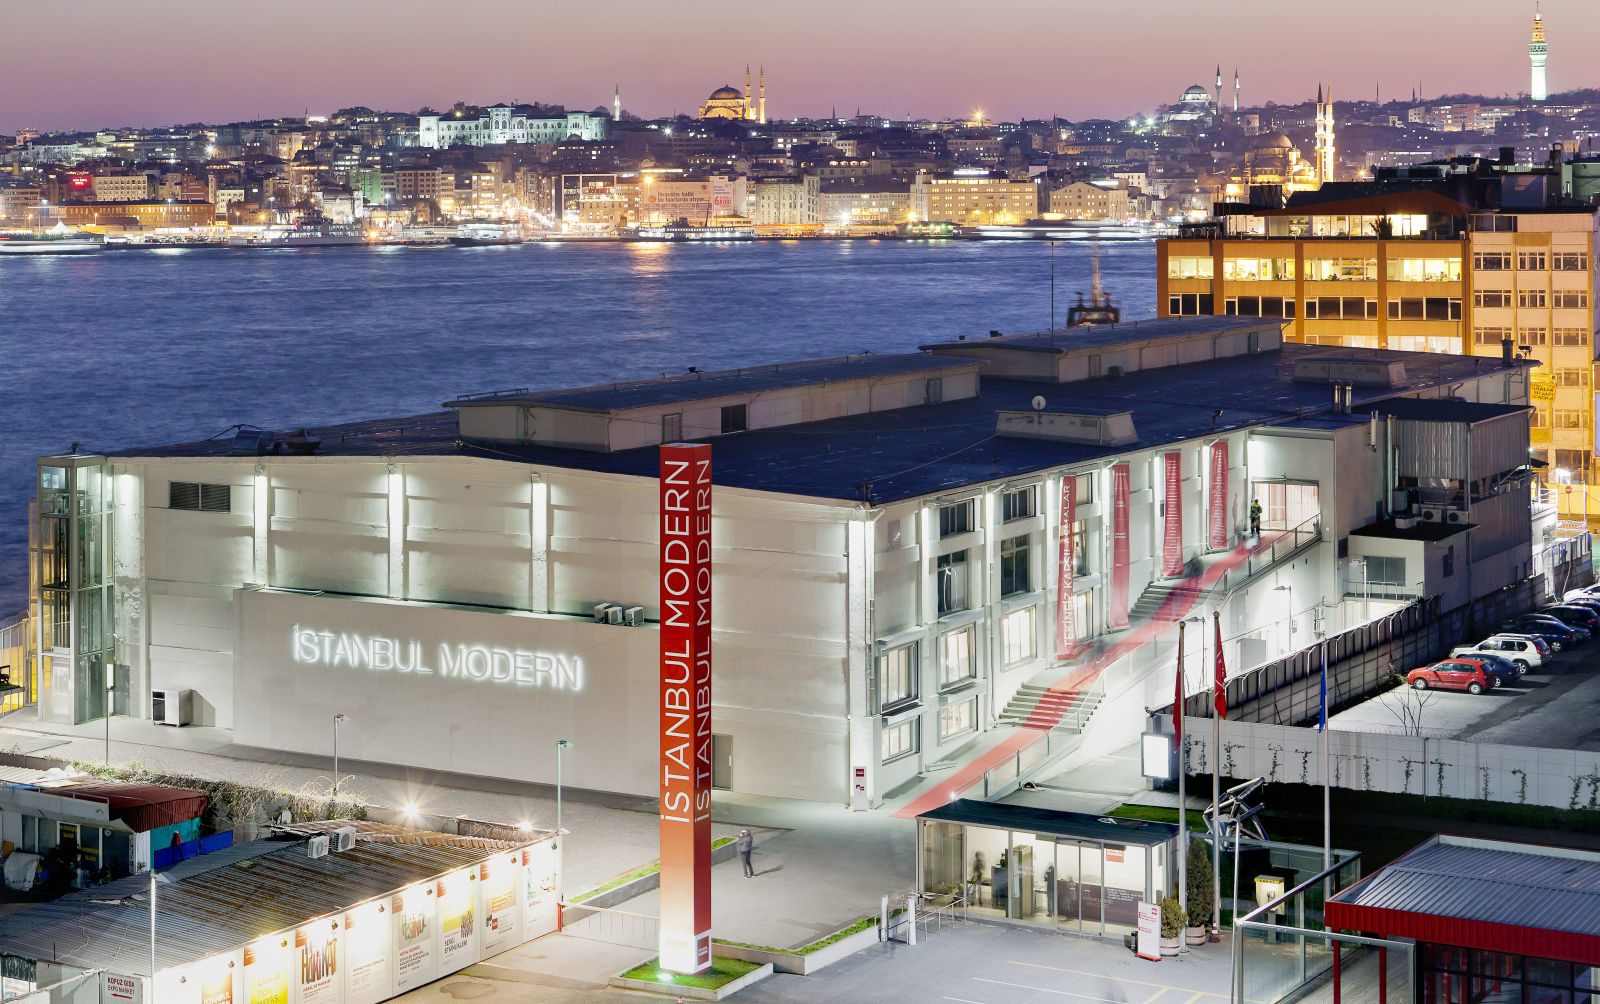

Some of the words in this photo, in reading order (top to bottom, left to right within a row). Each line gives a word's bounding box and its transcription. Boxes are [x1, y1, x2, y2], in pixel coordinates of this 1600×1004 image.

[664, 460, 690, 628] MODERN
[696, 459, 711, 627] MODERN
[439, 642, 584, 691] MODERN
[661, 640, 690, 823] İSTANBUL
[694, 636, 710, 823] İSTANBUL
